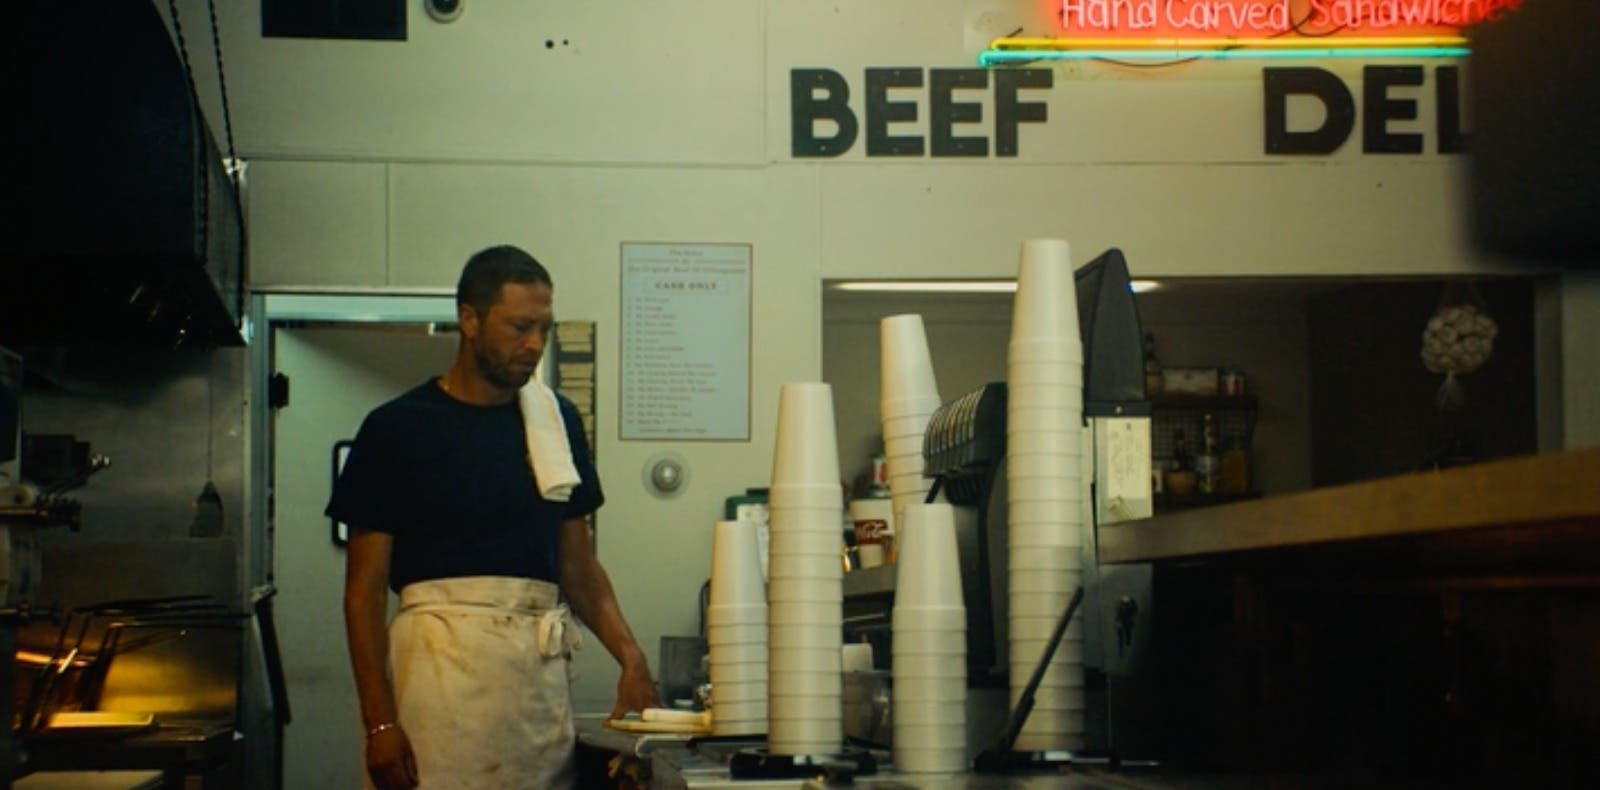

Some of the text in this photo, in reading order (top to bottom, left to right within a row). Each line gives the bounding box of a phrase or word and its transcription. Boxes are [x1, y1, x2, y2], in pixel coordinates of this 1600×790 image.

[1061, 0, 1520, 30] Hand Carved Sandwich
[790, 65, 1472, 158] BEEF DEL
